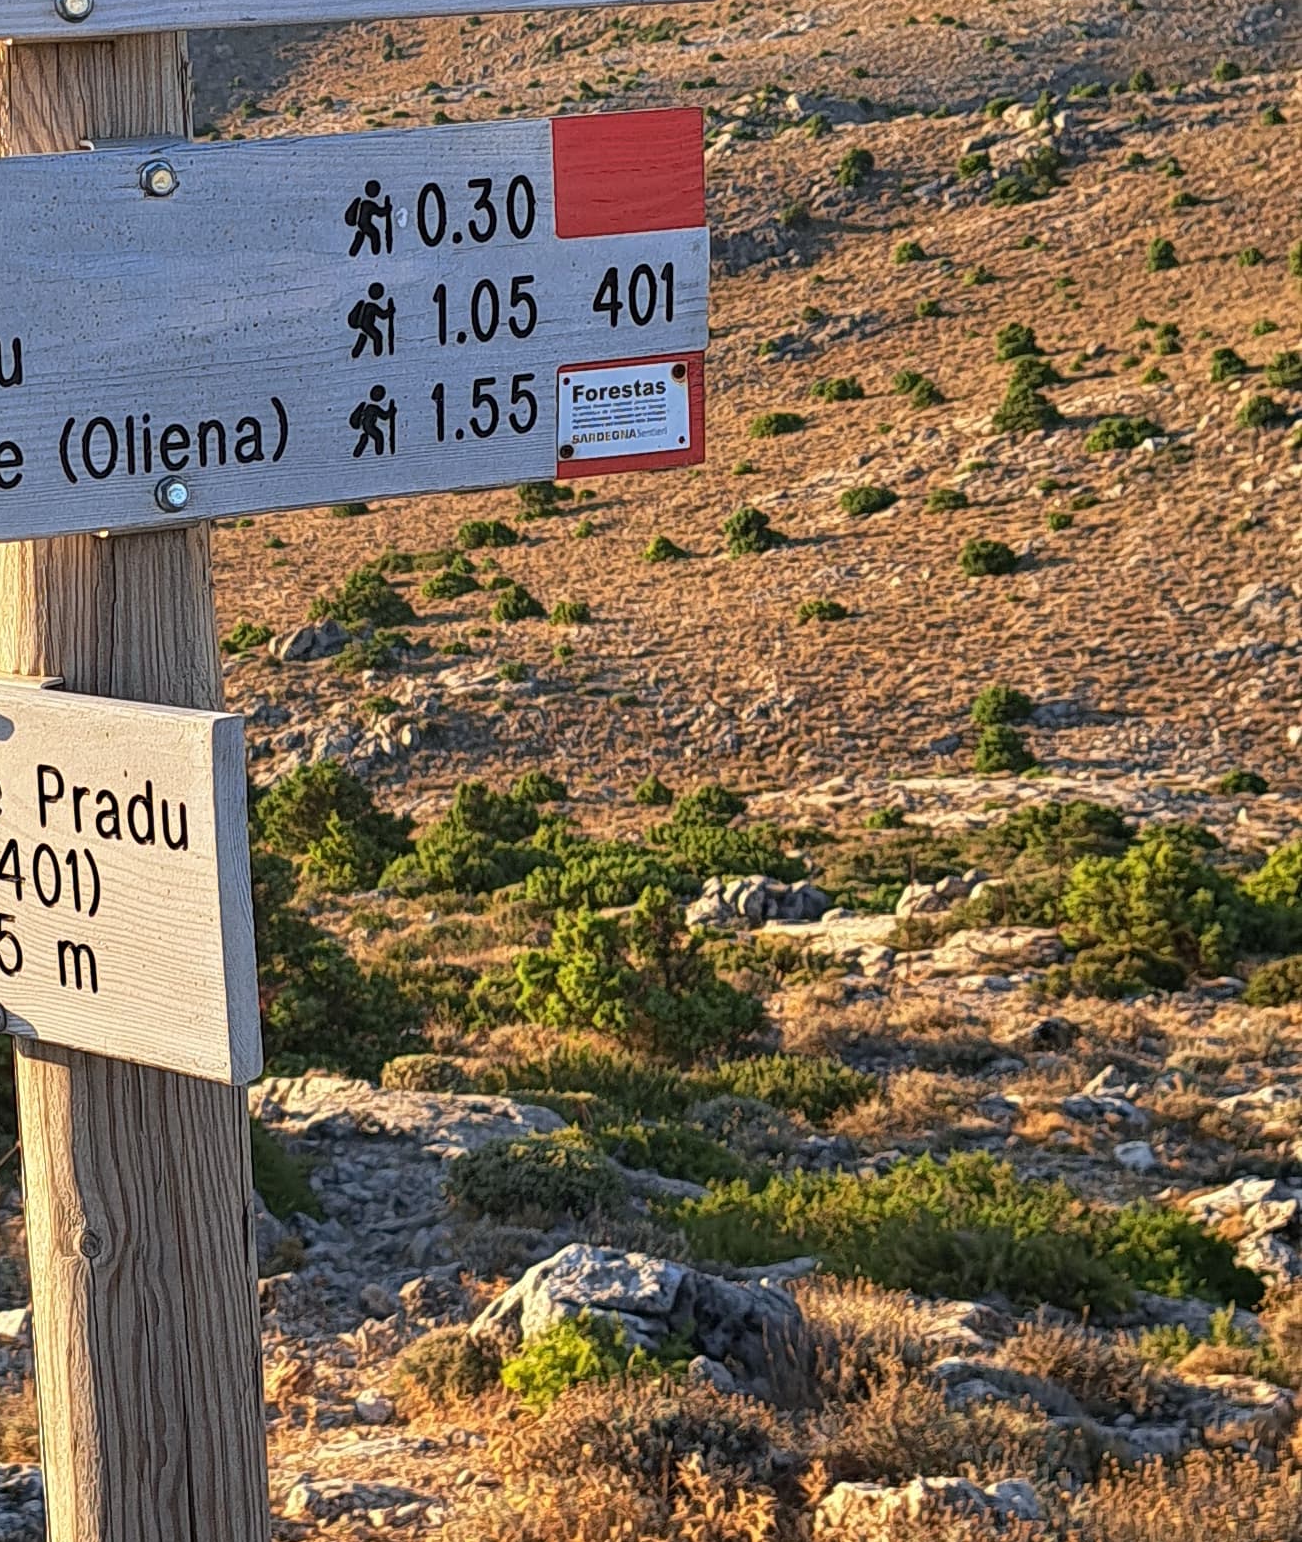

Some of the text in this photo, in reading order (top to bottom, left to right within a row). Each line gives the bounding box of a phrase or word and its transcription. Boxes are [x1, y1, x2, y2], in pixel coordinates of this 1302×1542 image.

[416, 174, 537, 248] 0.30
[432, 274, 538, 347] 1.05
[592, 261, 674, 329] 401
[571, 378, 667, 404] Forestas
[58, 396, 289, 484] (Oliena)
[430, 372, 538, 443] 1.55
[37, 764, 189, 851] Pradu
[57, 940, 98, 994] m
